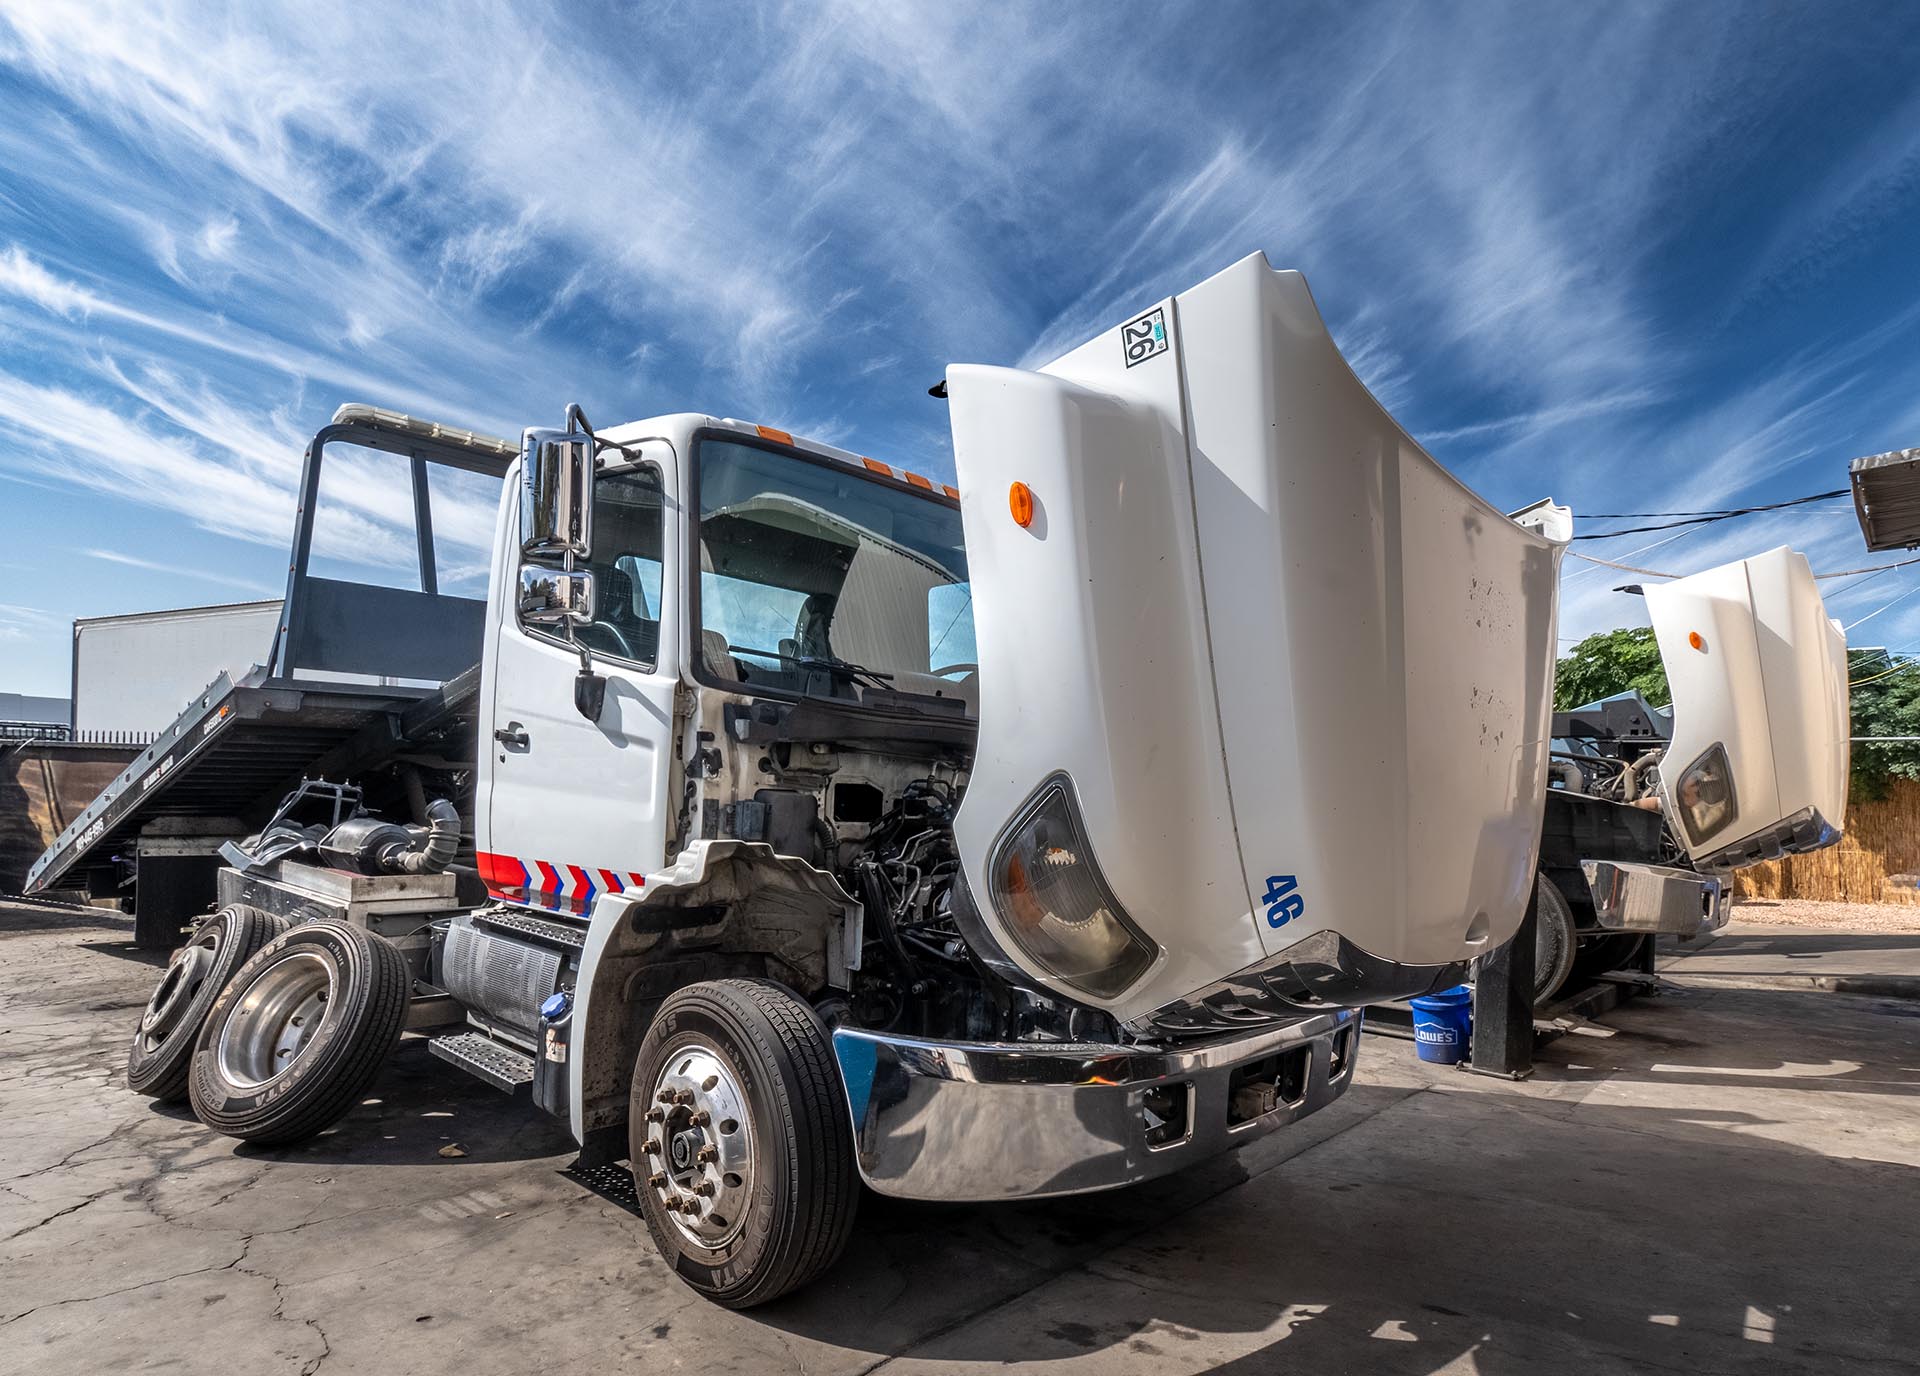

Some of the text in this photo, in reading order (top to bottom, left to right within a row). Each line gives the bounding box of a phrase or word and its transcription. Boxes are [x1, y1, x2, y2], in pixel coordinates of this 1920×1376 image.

[1126, 320, 1155, 360] 26
[1262, 875, 1304, 928] 46
[1416, 1027, 1454, 1043] LOWE'S
